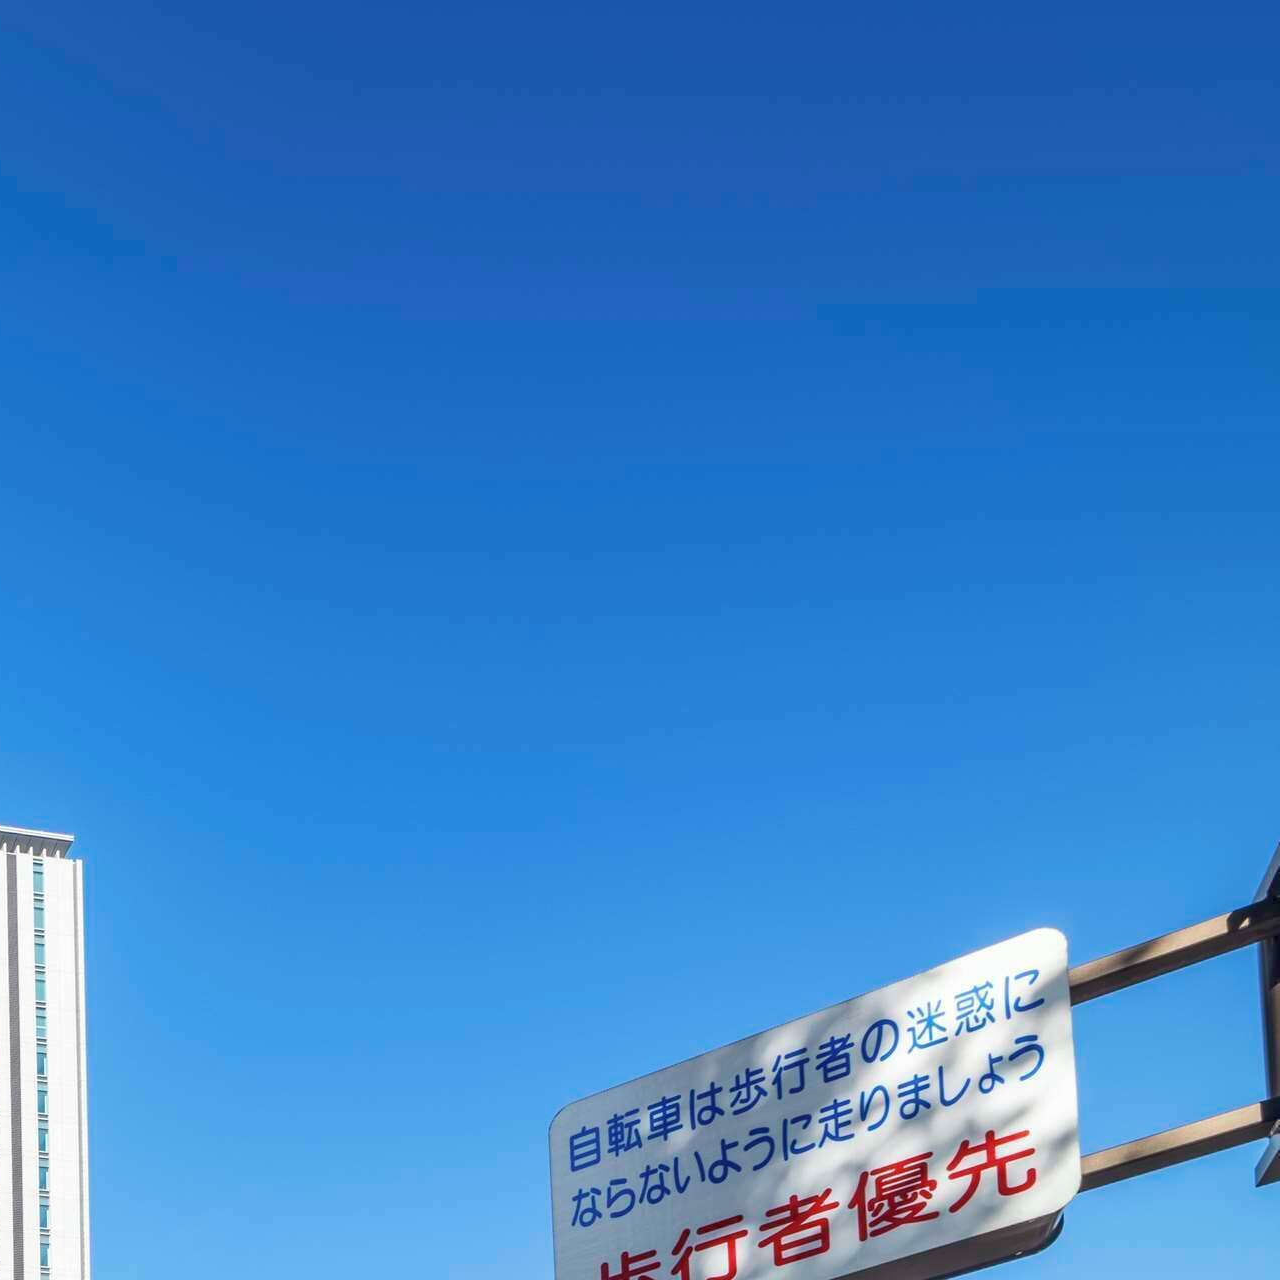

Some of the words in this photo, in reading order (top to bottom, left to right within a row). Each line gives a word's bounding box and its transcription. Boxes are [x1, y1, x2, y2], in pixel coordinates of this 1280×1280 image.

[570, 969, 1045, 1172] 自転車は歩行者の迷惑に
[571, 1034, 1045, 1227] ならないように走りましょう
